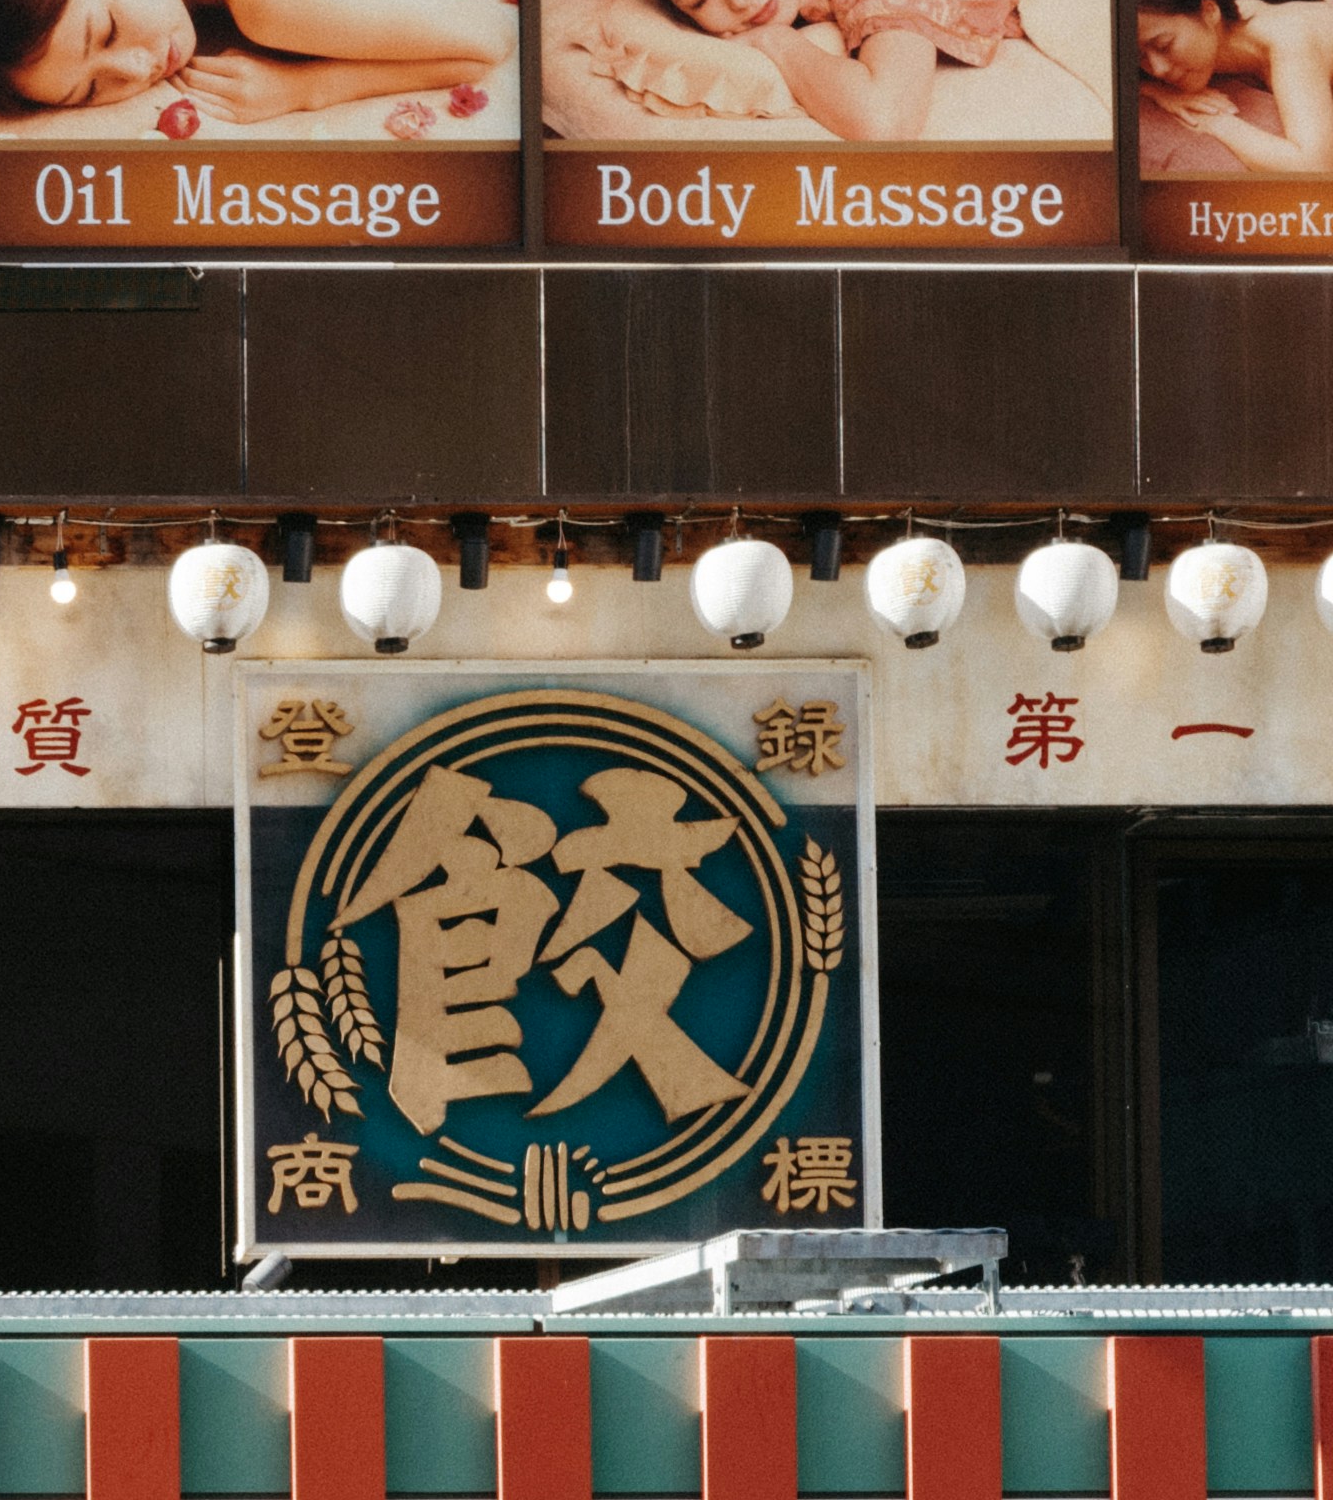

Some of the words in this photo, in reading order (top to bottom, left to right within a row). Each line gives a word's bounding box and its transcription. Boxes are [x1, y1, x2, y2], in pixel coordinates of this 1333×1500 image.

[36, 164, 131, 225] Oil
[172, 164, 440, 238] Massage
[597, 164, 756, 238] Body
[795, 165, 1065, 238] Massage
[1004, 690, 1256, 770] 第一
[329, 763, 755, 1137] 餃
